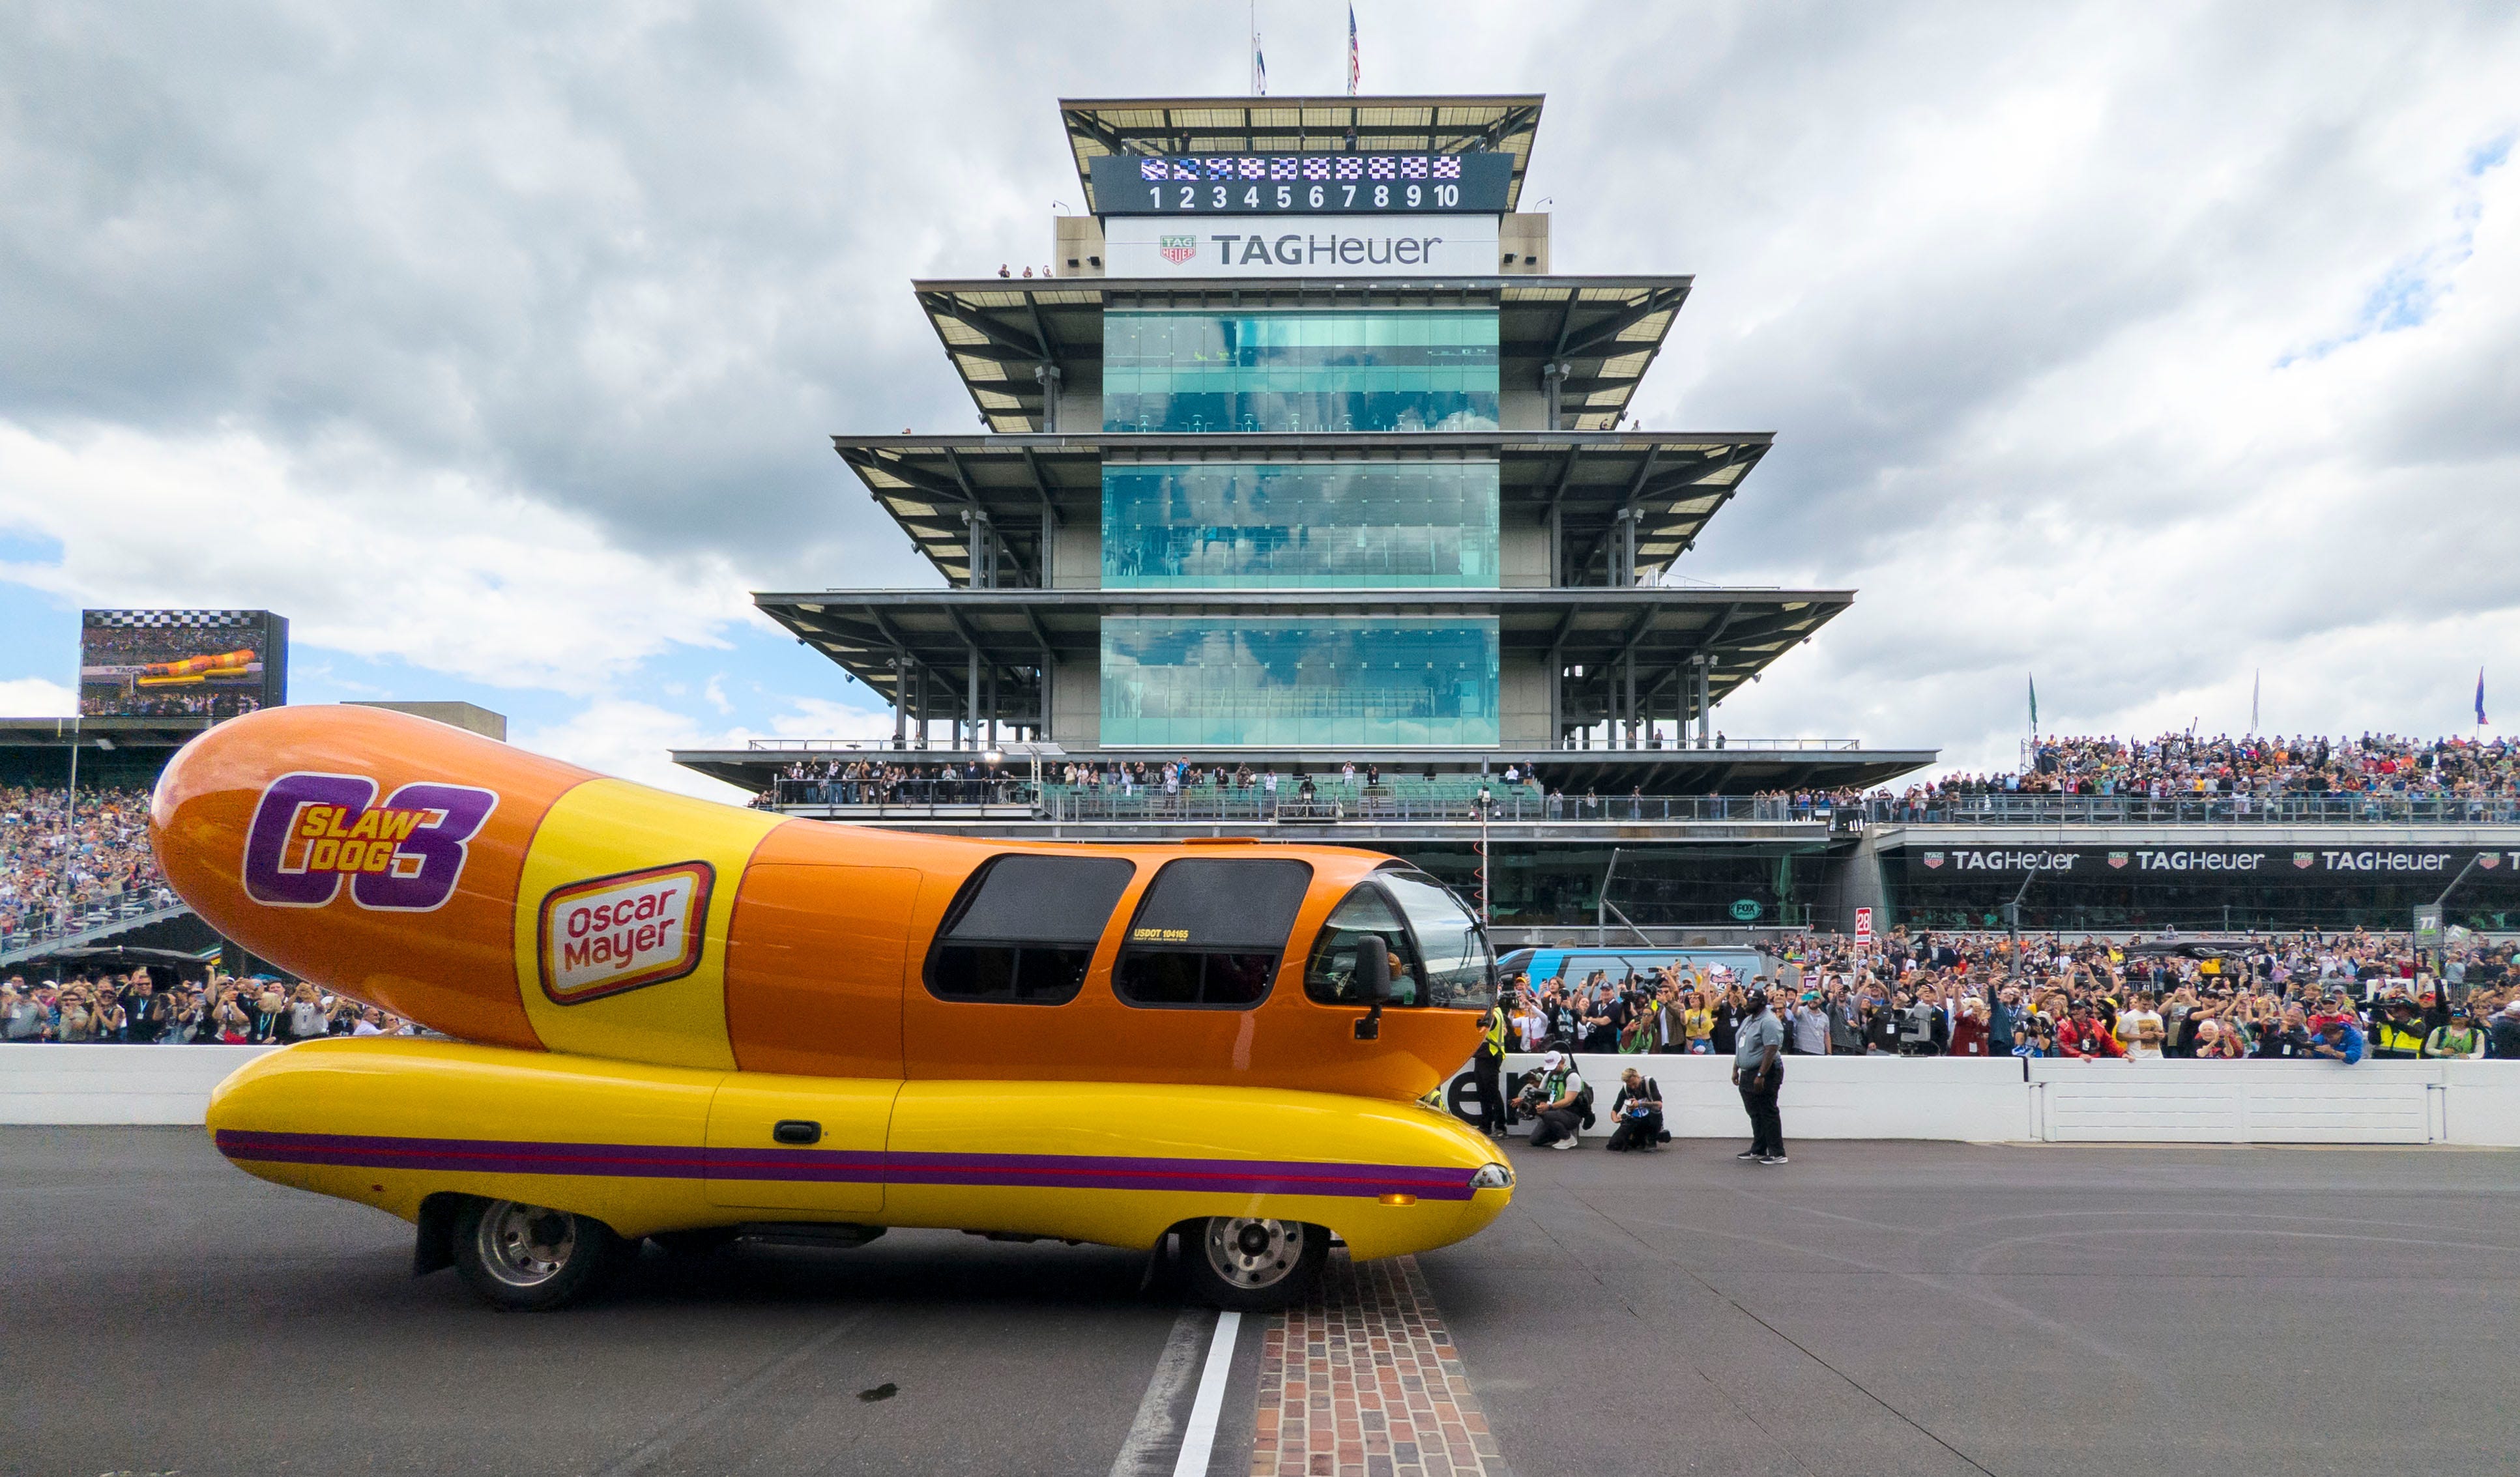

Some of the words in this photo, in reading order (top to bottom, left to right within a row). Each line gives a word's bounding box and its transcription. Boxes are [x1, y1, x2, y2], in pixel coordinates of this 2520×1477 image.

[1150, 186, 1160, 208] 1
[1180, 186, 1195, 208] 2
[1213, 186, 1226, 208] 3
[1244, 186, 1259, 208] 4
[1277, 186, 1292, 208] 5
[1309, 186, 1324, 208] 6
[1342, 186, 1356, 208] 7
[1374, 186, 1389, 208] 8
[1406, 186, 1421, 208] 9
[1434, 186, 1459, 208] 10
[1163, 238, 1193, 247] TAG
[1211, 235, 1443, 265] TAGHeuer
[1162, 248, 1194, 262] HEUER
[301, 806, 425, 840] SLAW
[310, 839, 394, 872] DOG
[2136, 851, 2265, 870] TAGHeuer
[2321, 851, 2450, 870] TAGHeuer
[567, 889, 678, 938] Oscar
[1736, 904, 1755, 912] FOX
[1857, 913, 1870, 931] 28
[2420, 916, 2437, 930] 77
[1134, 928, 1162, 938] USDOT
[1163, 929, 1189, 938] 104165
[564, 918, 676, 972] Mayer
